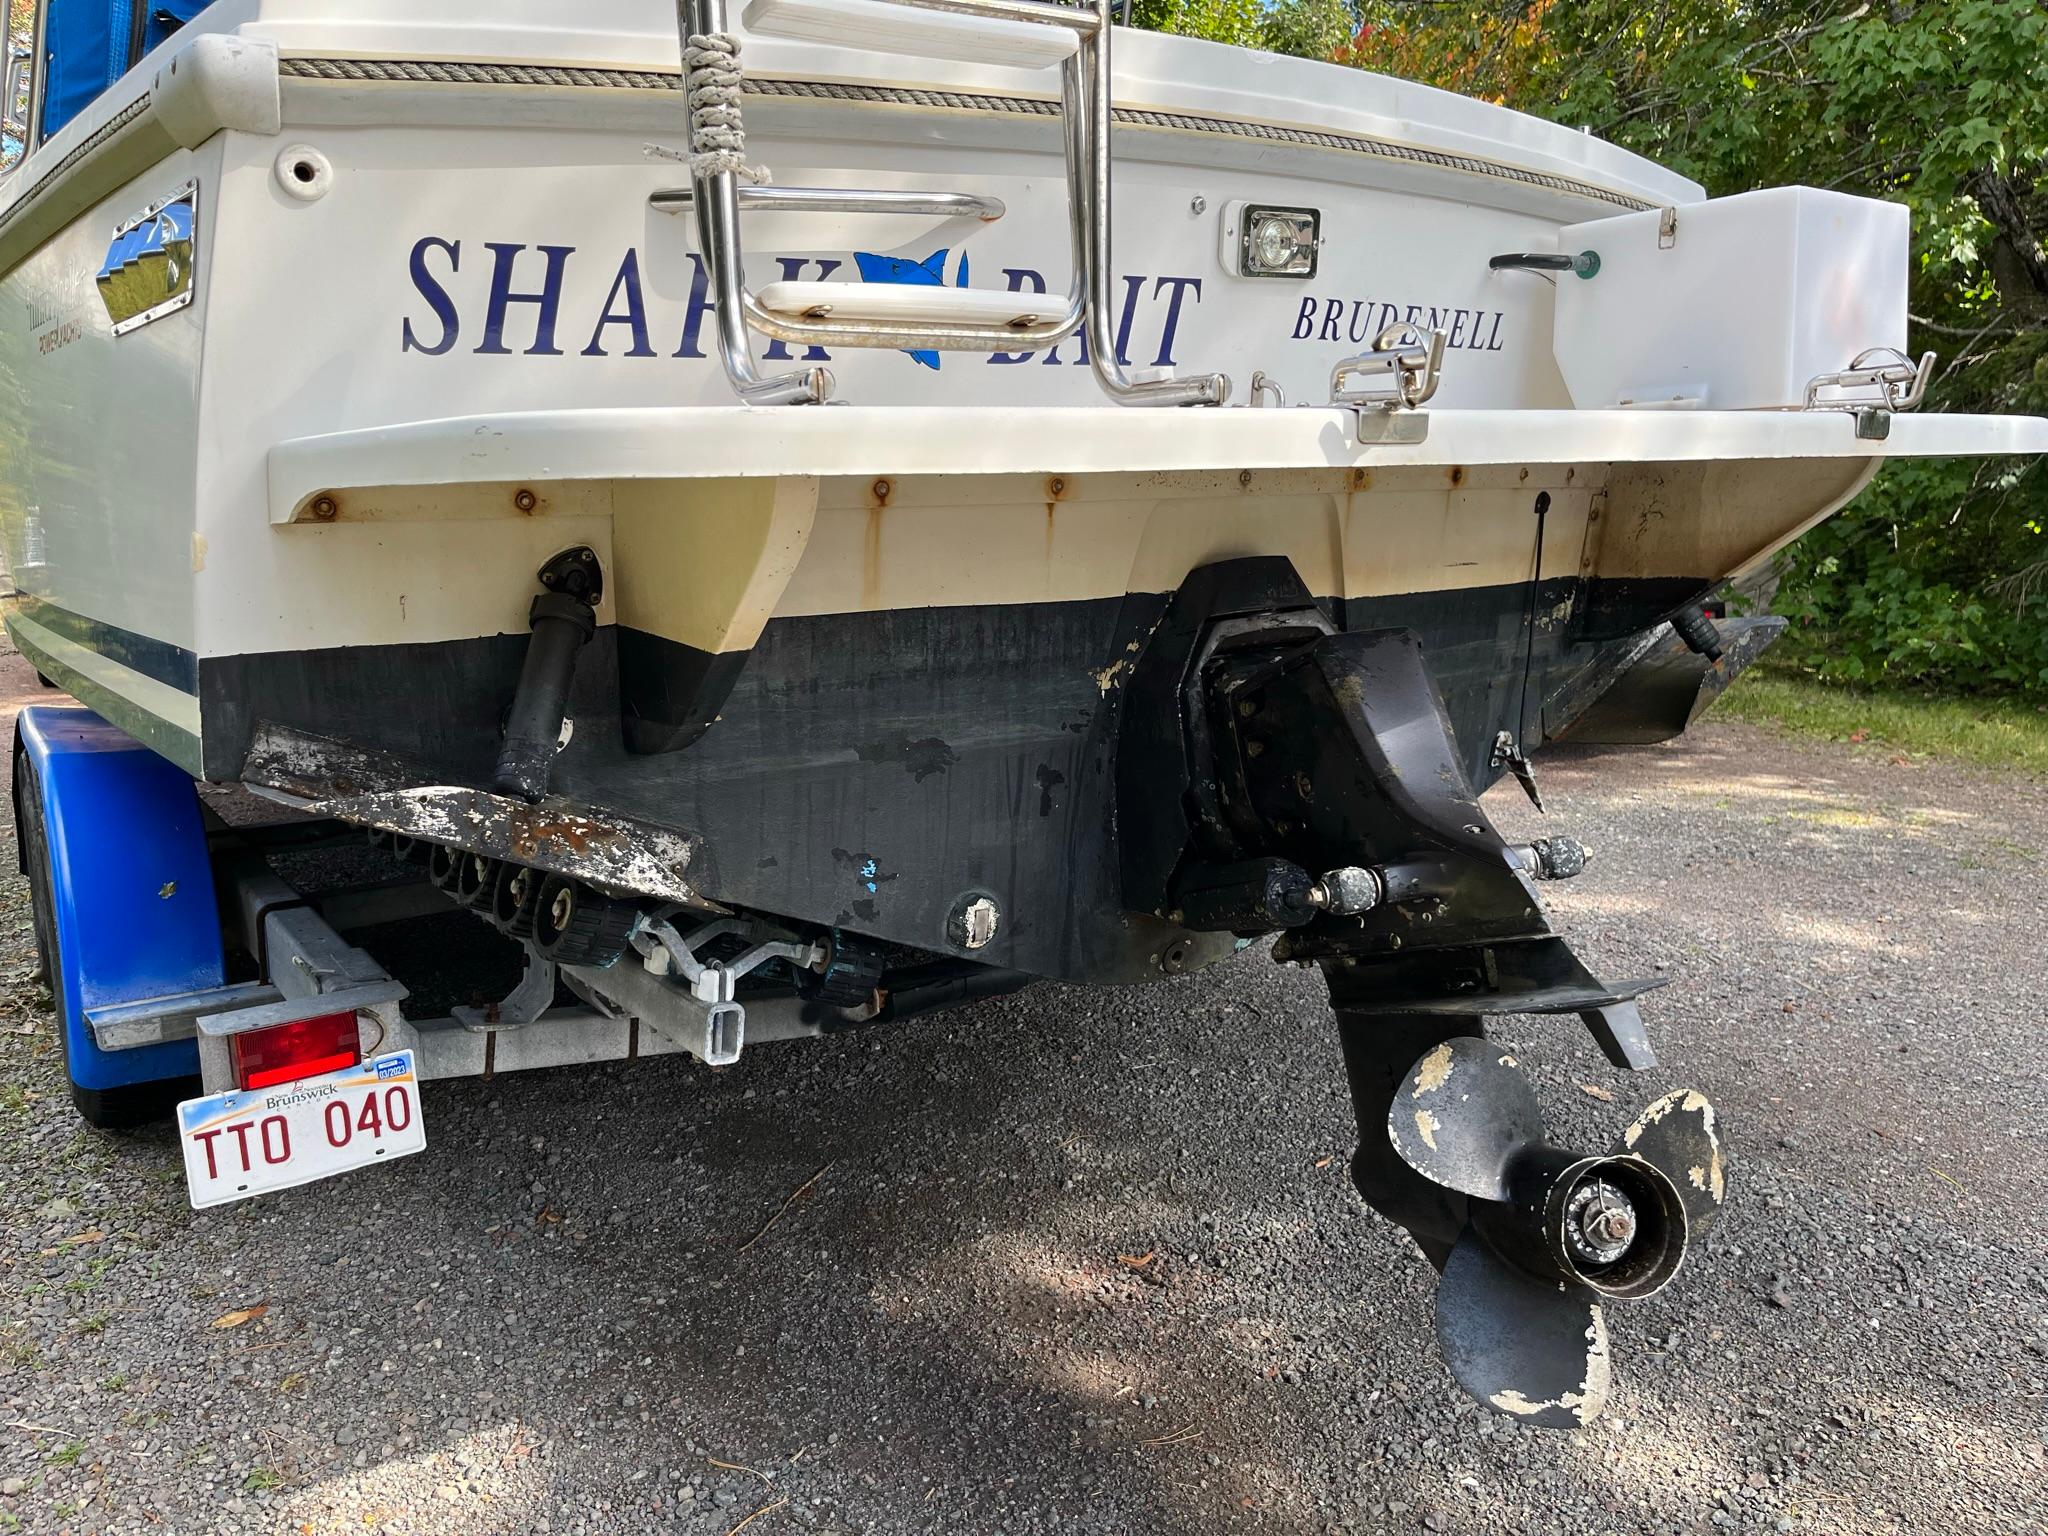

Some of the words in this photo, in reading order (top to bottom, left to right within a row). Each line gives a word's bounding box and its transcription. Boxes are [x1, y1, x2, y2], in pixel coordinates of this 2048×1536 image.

[1291, 297, 1504, 351] BRUDENELL
[266, 1083, 338, 1109] Brunswick
[193, 1115, 292, 1180] TTO
[324, 1086, 411, 1148] 040
